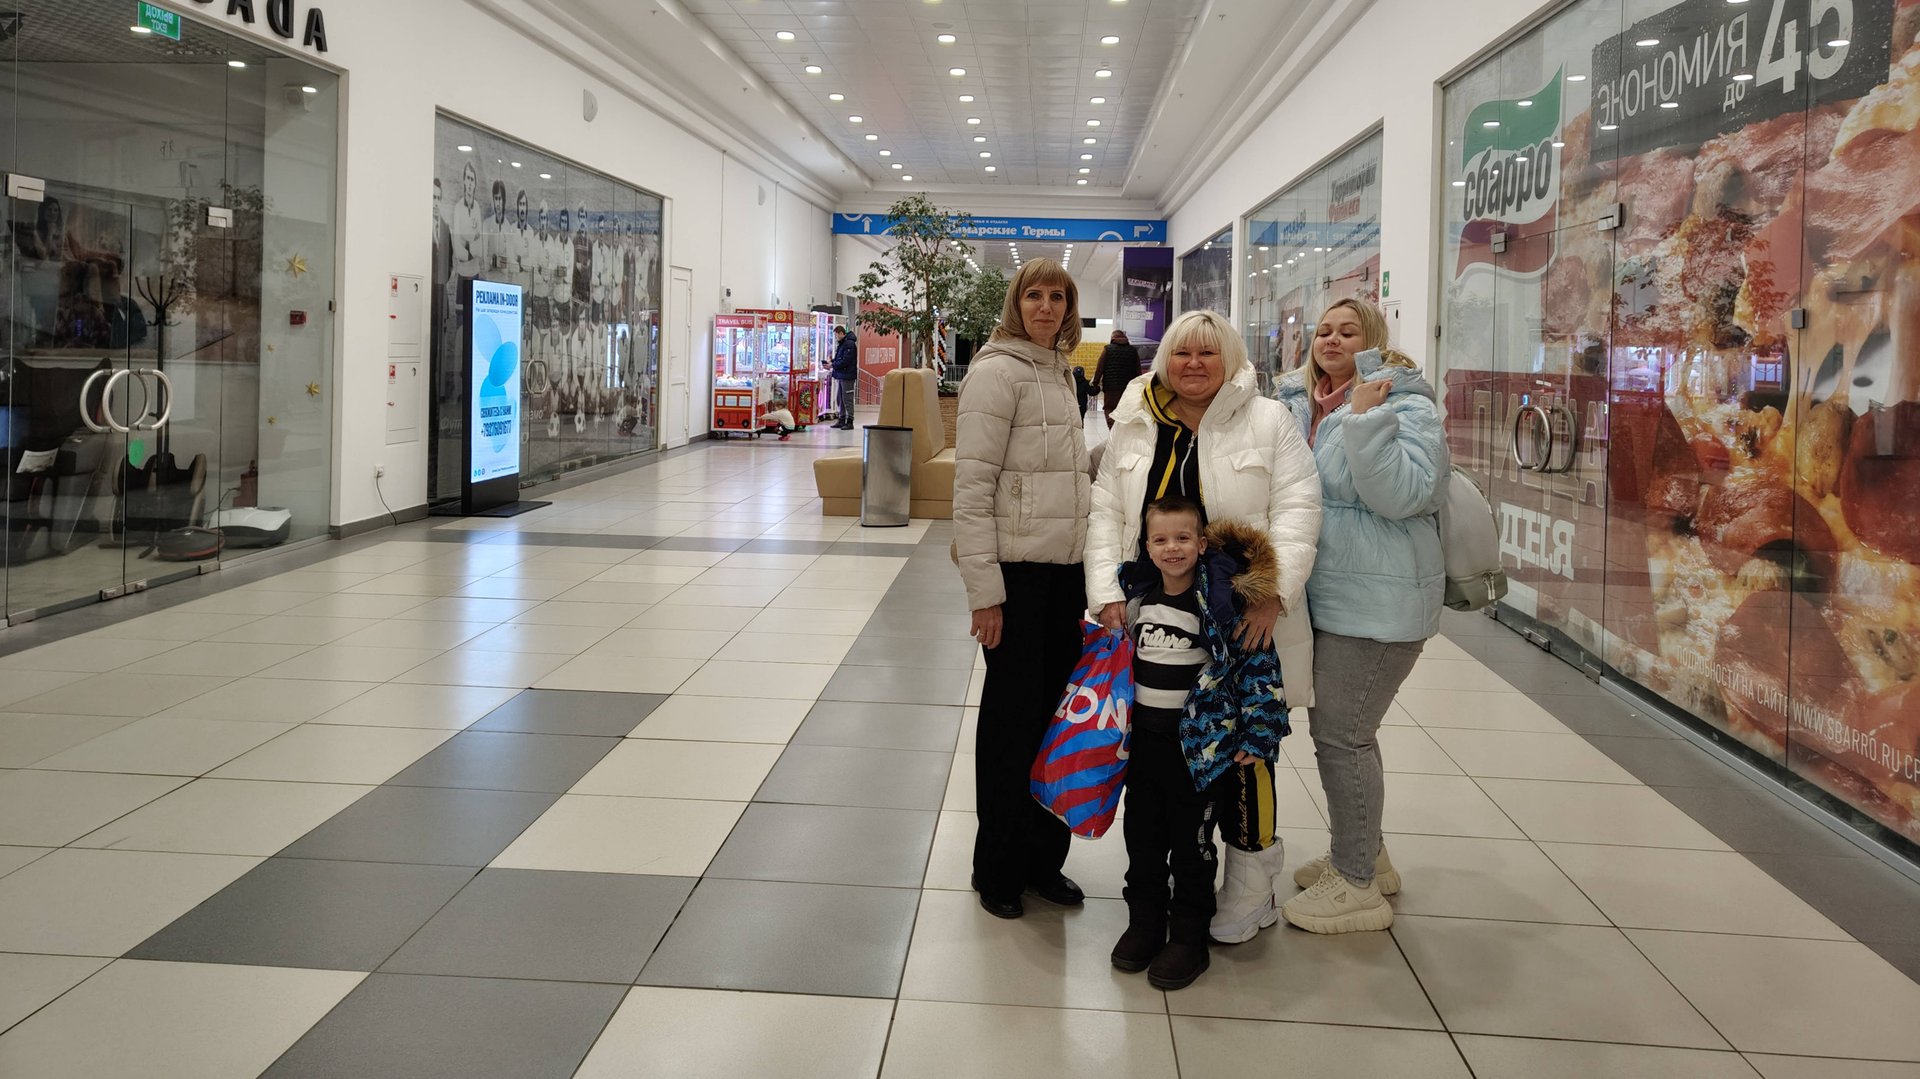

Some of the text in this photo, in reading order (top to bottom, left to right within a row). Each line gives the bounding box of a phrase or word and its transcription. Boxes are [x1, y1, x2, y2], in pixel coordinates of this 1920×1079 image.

[1596, 12, 1748, 127] ЭКОНОМИЯ
[1463, 141, 1553, 222] сбарро
[1021, 225, 1066, 238] Термы
[475, 290, 499, 304] РЕКЛАМА
[1138, 623, 1192, 649] Future
[1677, 645, 1740, 693] ПОДРОБНОСТИ
[1740, 676, 1755, 699] НА
[1757, 682, 1790, 718] САЙТЕ
[1791, 698, 1901, 773] WWW.SBARRO.RU
